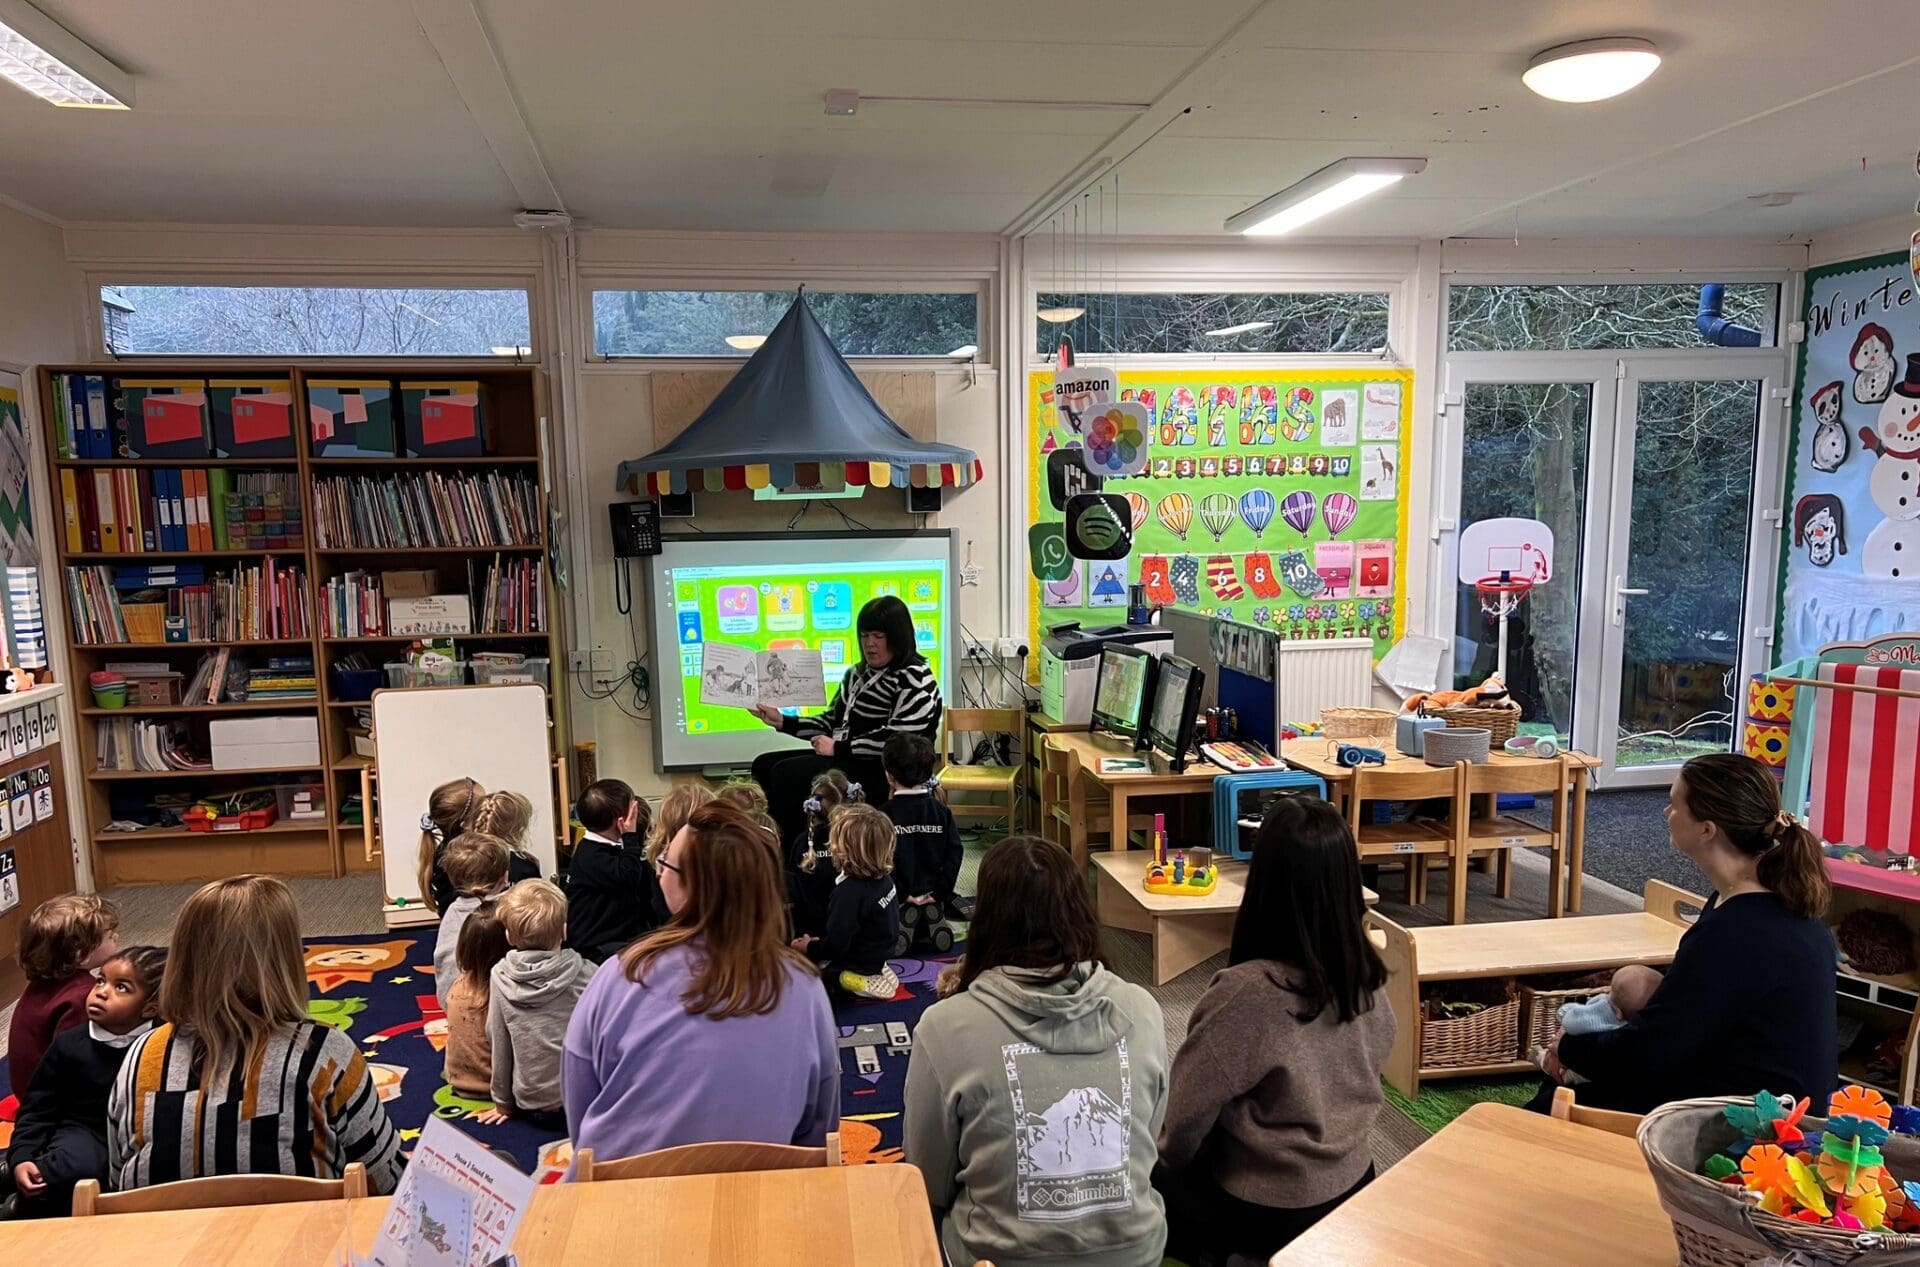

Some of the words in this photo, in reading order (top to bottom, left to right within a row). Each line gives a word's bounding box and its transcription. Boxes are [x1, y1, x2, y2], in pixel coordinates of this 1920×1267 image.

[1808, 277, 1916, 337] Winte
[1056, 379, 1110, 395] amazon
[1158, 460, 1168, 475] 2
[1181, 460, 1191, 475] 3
[1204, 460, 1214, 474] 4
[1228, 459, 1238, 473] 5
[1250, 458, 1260, 472] 6
[1270, 459, 1281, 473] 7
[1293, 457, 1303, 470] 8
[1314, 458, 1324, 472] 9
[1333, 459, 1349, 470] 10
[1244, 504, 1270, 515] Friday
[1282, 502, 1316, 517] Saturday
[1324, 504, 1354, 518] Sunday
[1150, 571, 1160, 587] 2
[1177, 570, 1188, 586] 4
[1218, 570, 1228, 586] 6
[1254, 567, 1265, 583] 8
[1286, 564, 1308, 583] 10
[1216, 621, 1264, 676] STEM
[0, 730, 7, 751] 7
[12, 725, 24, 746] 18
[28, 719, 38, 740] 19
[44, 713, 56, 734] 20
[14, 777, 27, 794] Nn
[37, 768, 49, 785] Oo
[0, 853, 14, 873] Zz
[1051, 1183, 1122, 1207] Columbia
